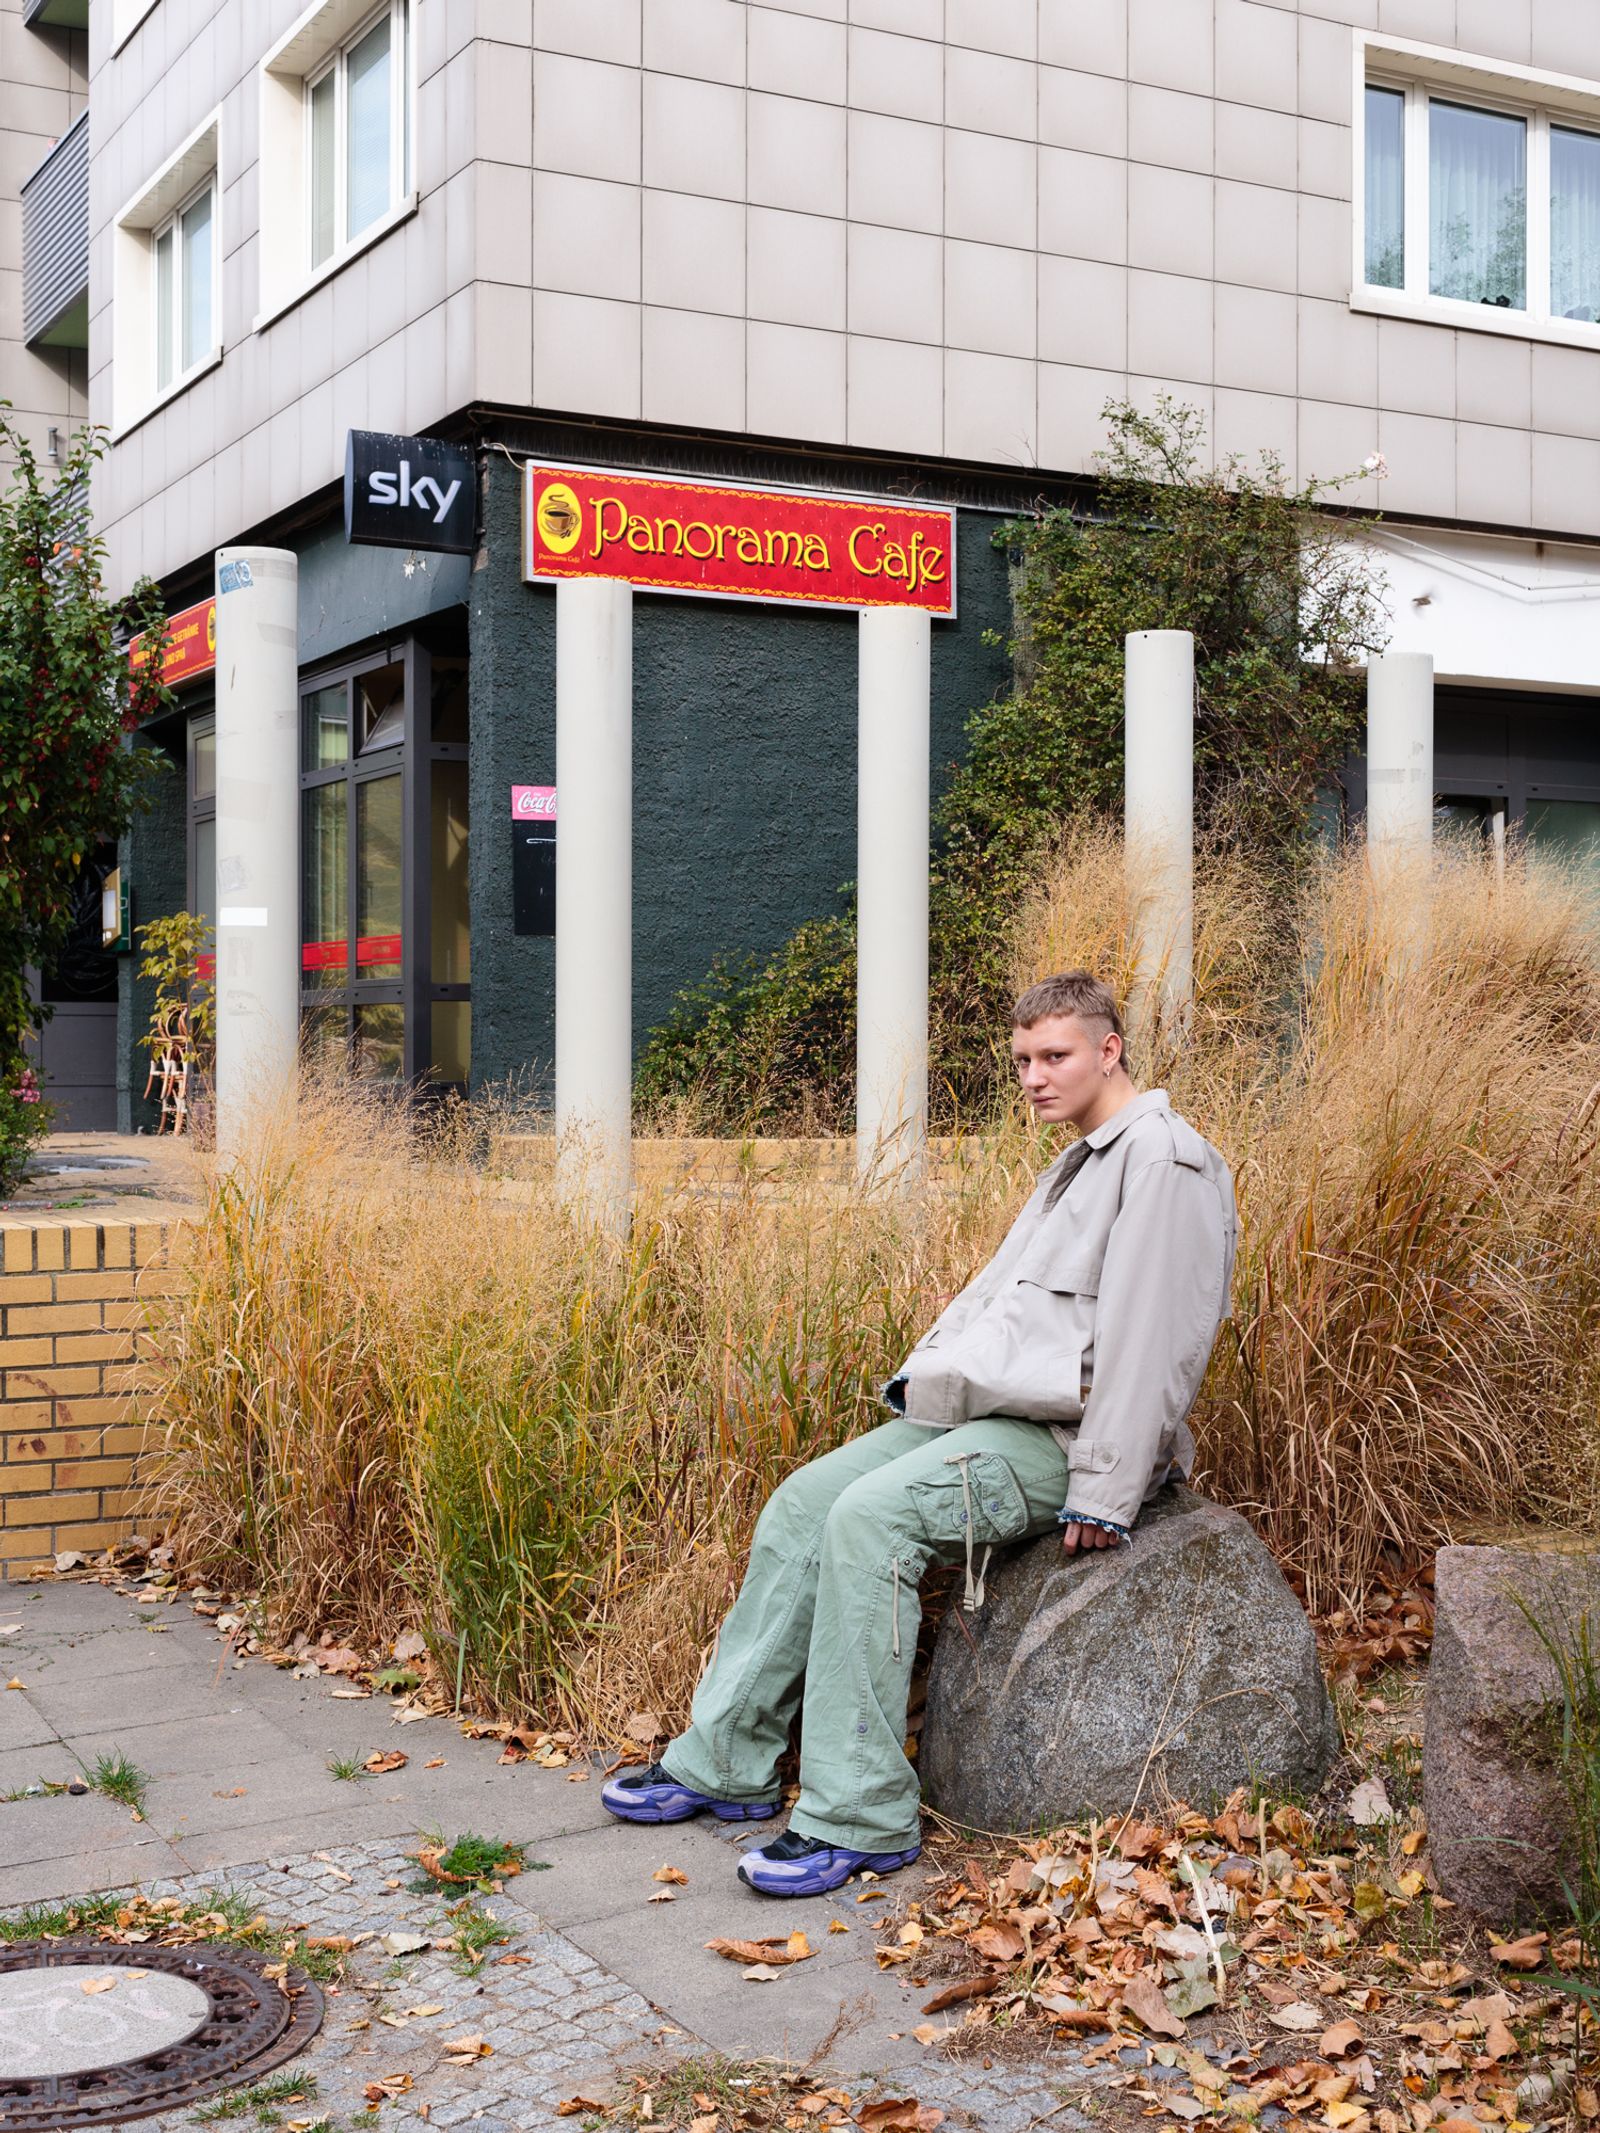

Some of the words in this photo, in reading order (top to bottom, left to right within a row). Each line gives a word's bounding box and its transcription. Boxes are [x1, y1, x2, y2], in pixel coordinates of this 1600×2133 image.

[368, 460, 462, 524] sky
[588, 496, 832, 572] Panorama
[848, 522, 945, 594] Cafe
